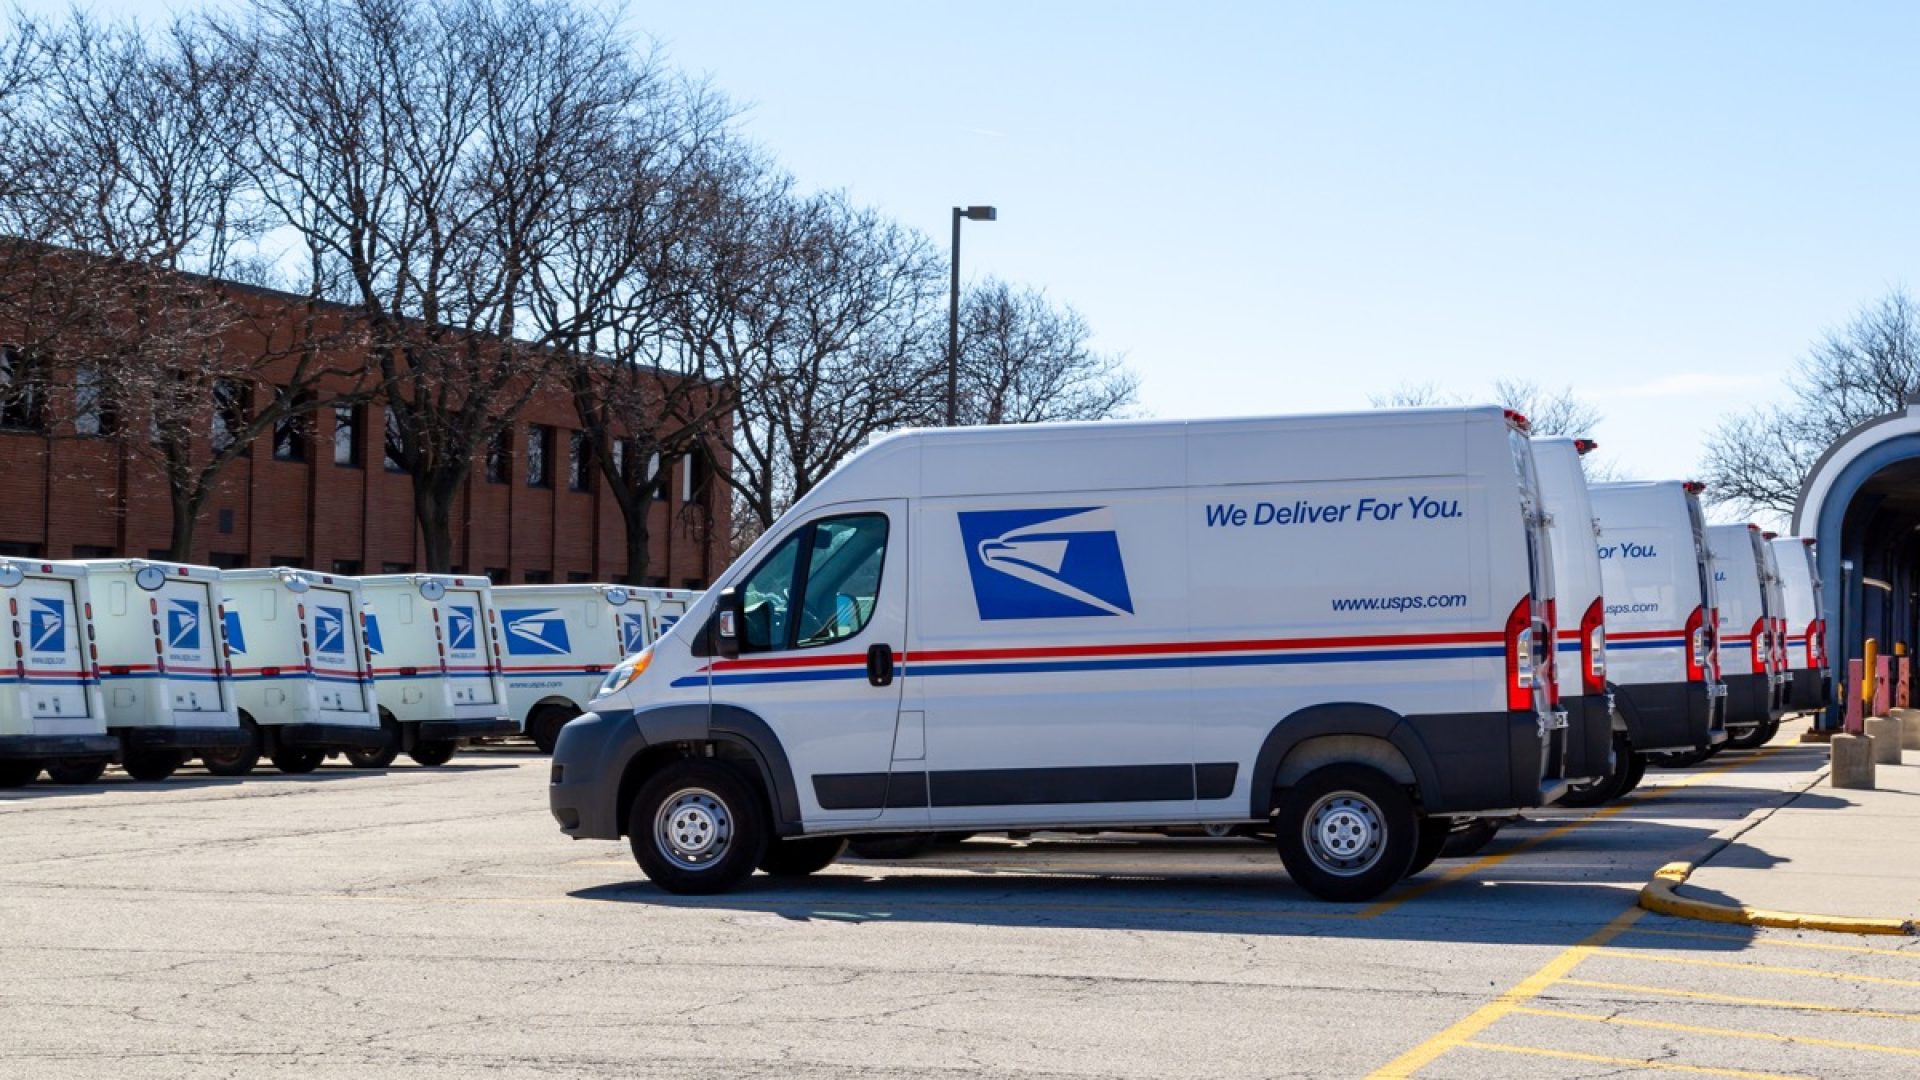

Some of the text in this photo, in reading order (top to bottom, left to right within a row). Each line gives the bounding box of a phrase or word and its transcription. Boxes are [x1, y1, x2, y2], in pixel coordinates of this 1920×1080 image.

[1205, 495, 1463, 527] We Deliver For You.
[1597, 542, 1657, 559] or You.
[1331, 594, 1467, 612] www.usps.com
